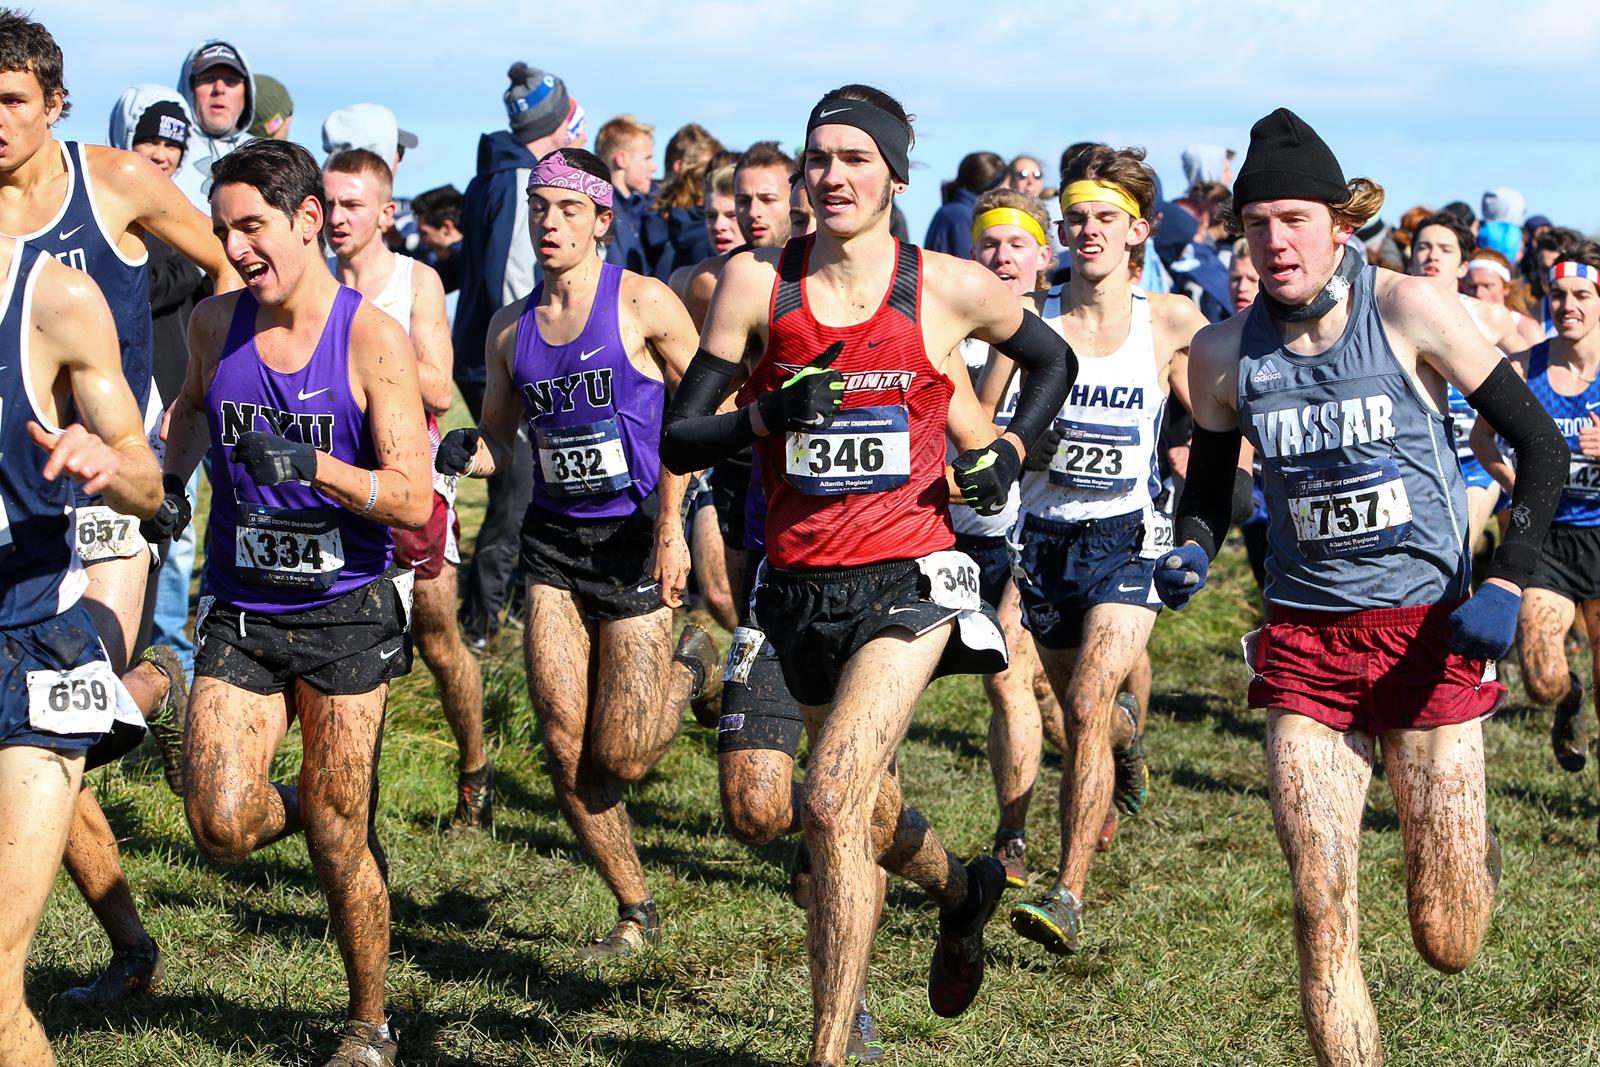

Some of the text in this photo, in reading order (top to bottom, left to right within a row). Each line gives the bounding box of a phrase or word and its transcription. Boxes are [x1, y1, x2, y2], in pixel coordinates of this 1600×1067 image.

[1253, 371, 1281, 382] adidas
[523, 368, 613, 421] NYU
[1069, 384, 1144, 409] HACA
[1252, 394, 1396, 458] VASSAR
[551, 448, 607, 480] 332
[808, 438, 884, 474] 346
[1066, 445, 1123, 475] 223
[845, 479, 873, 488] Regional
[1091, 479, 1113, 487] Regional
[1342, 470, 1383, 486] CHAMPIONSHIPS
[1310, 491, 1379, 536] 757
[79, 519, 130, 545] 657
[1154, 526, 1174, 546] 22
[1352, 534, 1380, 545] Regional
[257, 533, 324, 570] 334
[938, 566, 977, 593] 346
[48, 679, 108, 712] 659
